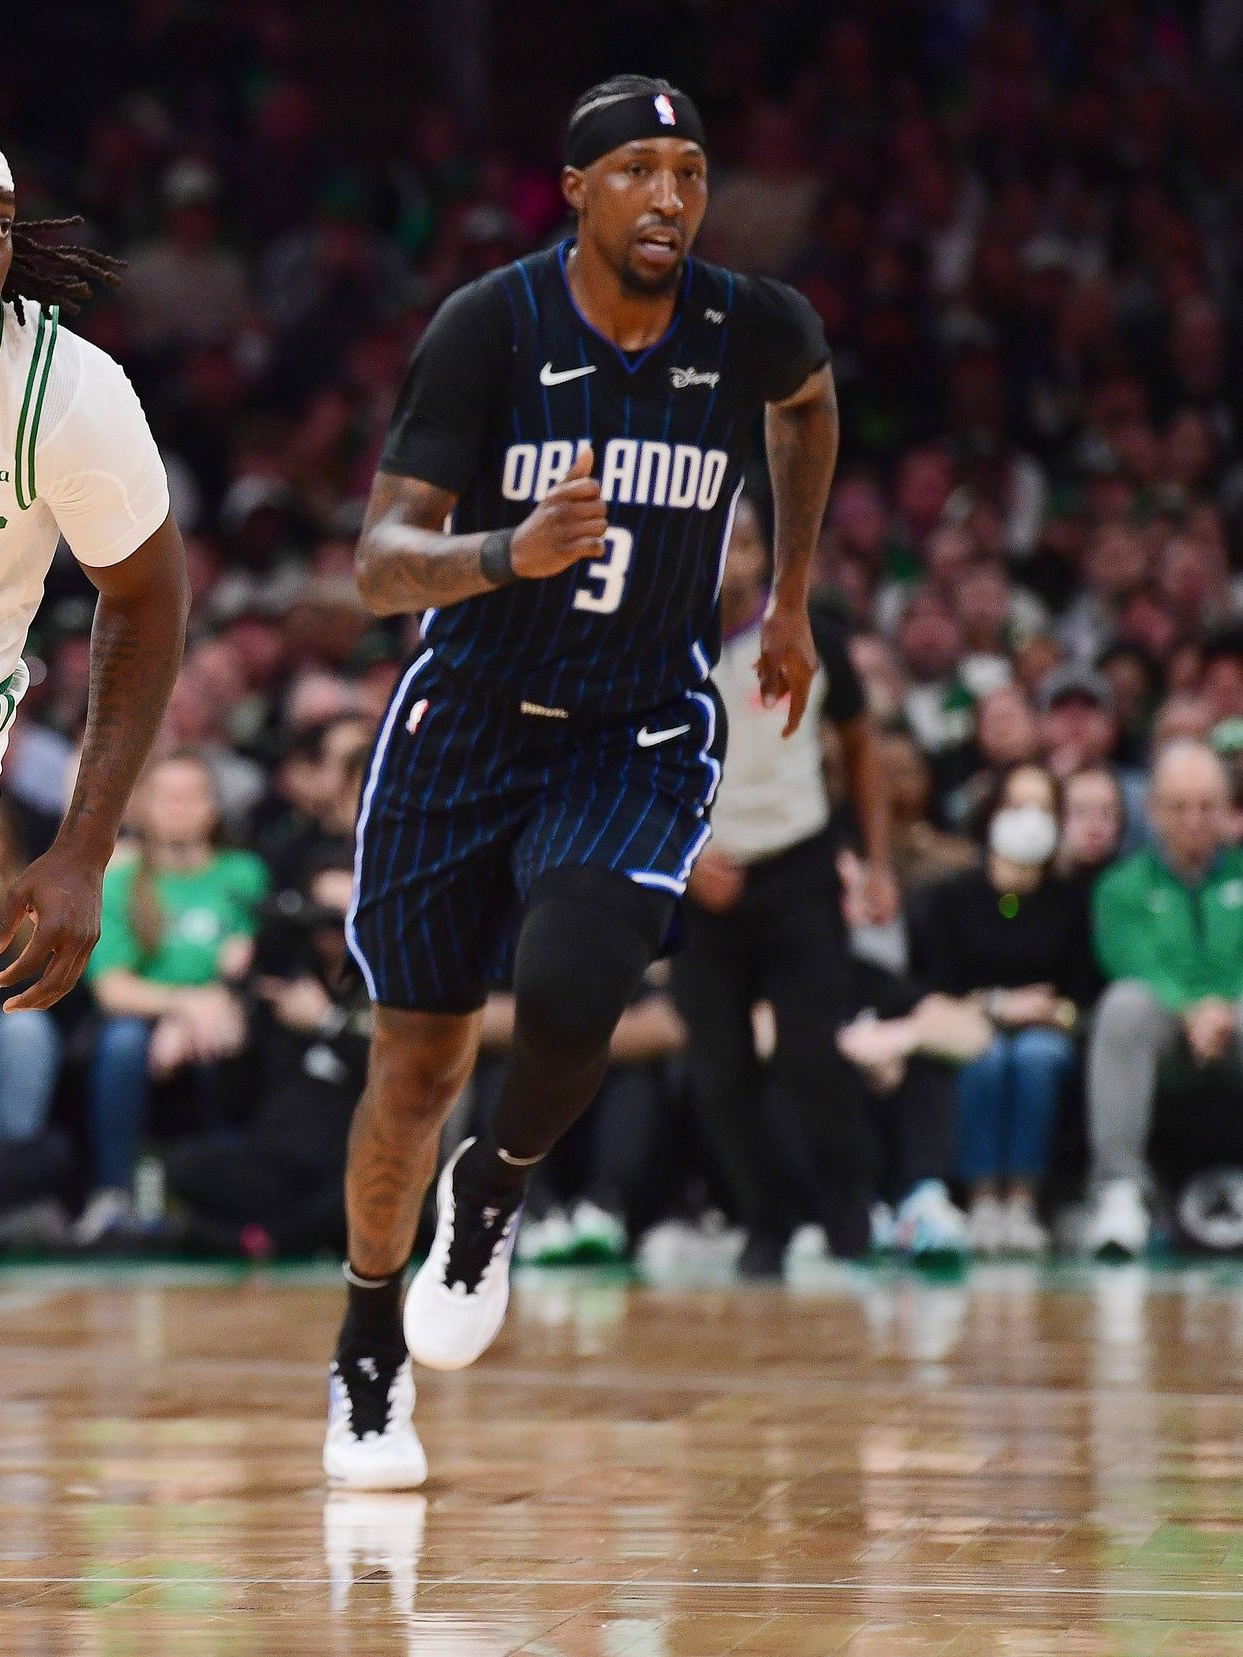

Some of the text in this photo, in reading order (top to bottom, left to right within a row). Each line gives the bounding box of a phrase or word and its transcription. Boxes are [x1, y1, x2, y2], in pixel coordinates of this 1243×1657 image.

[668, 366, 721, 389] Disney
[502, 438, 728, 511] ORANDO
[572, 526, 634, 614] 3
